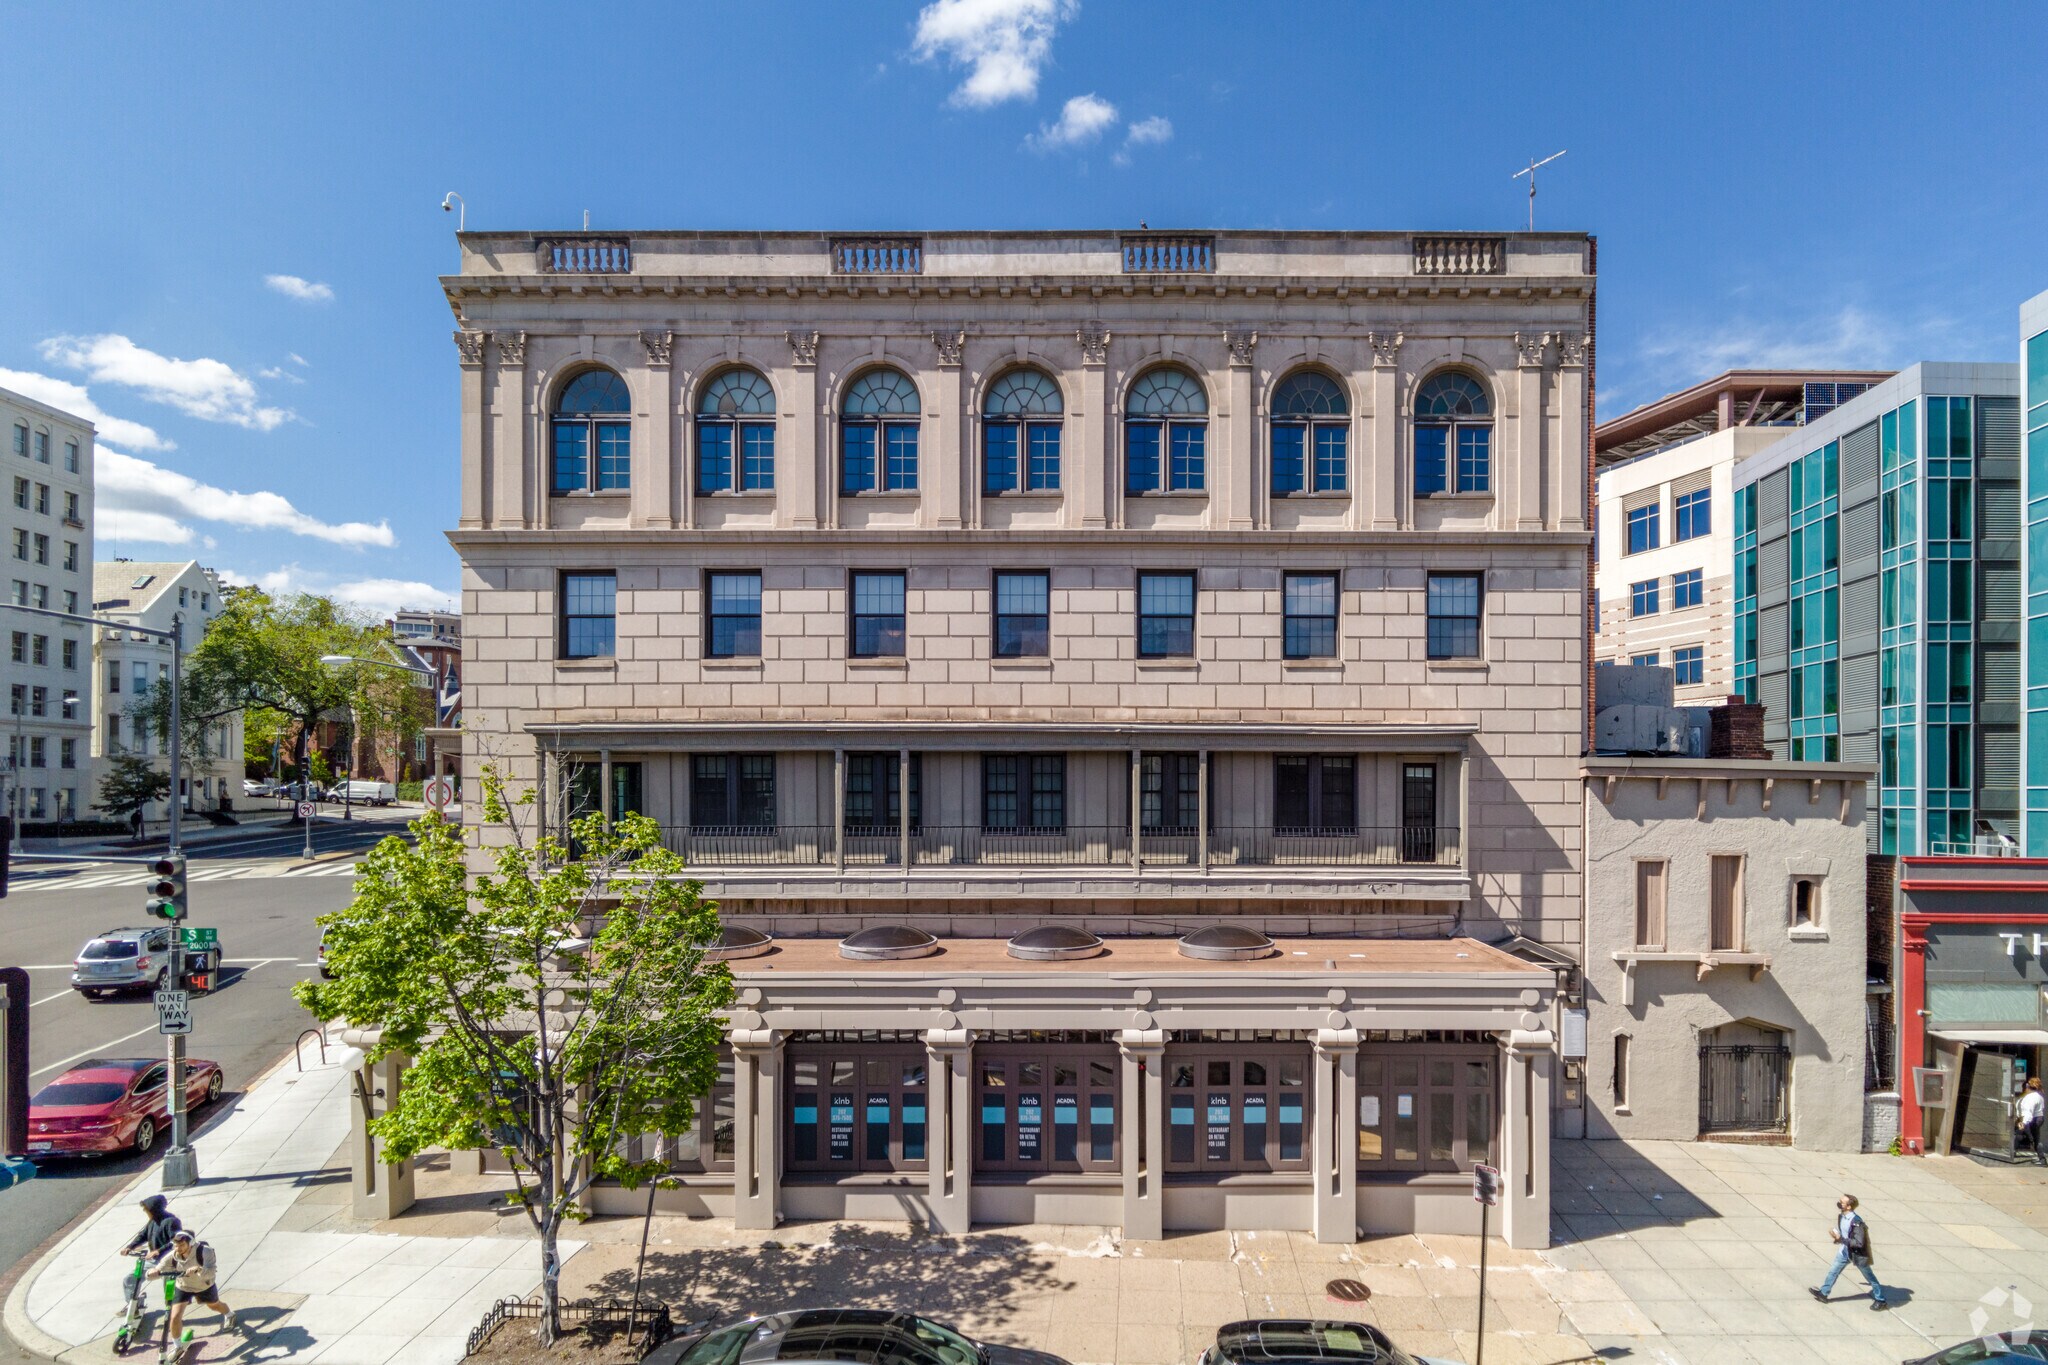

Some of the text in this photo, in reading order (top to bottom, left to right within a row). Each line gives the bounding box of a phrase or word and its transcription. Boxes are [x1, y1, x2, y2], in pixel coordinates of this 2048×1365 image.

[188, 930, 196, 940] S
[1999, 933, 2048, 956] TH
[165, 1011, 188, 1019] WAY
